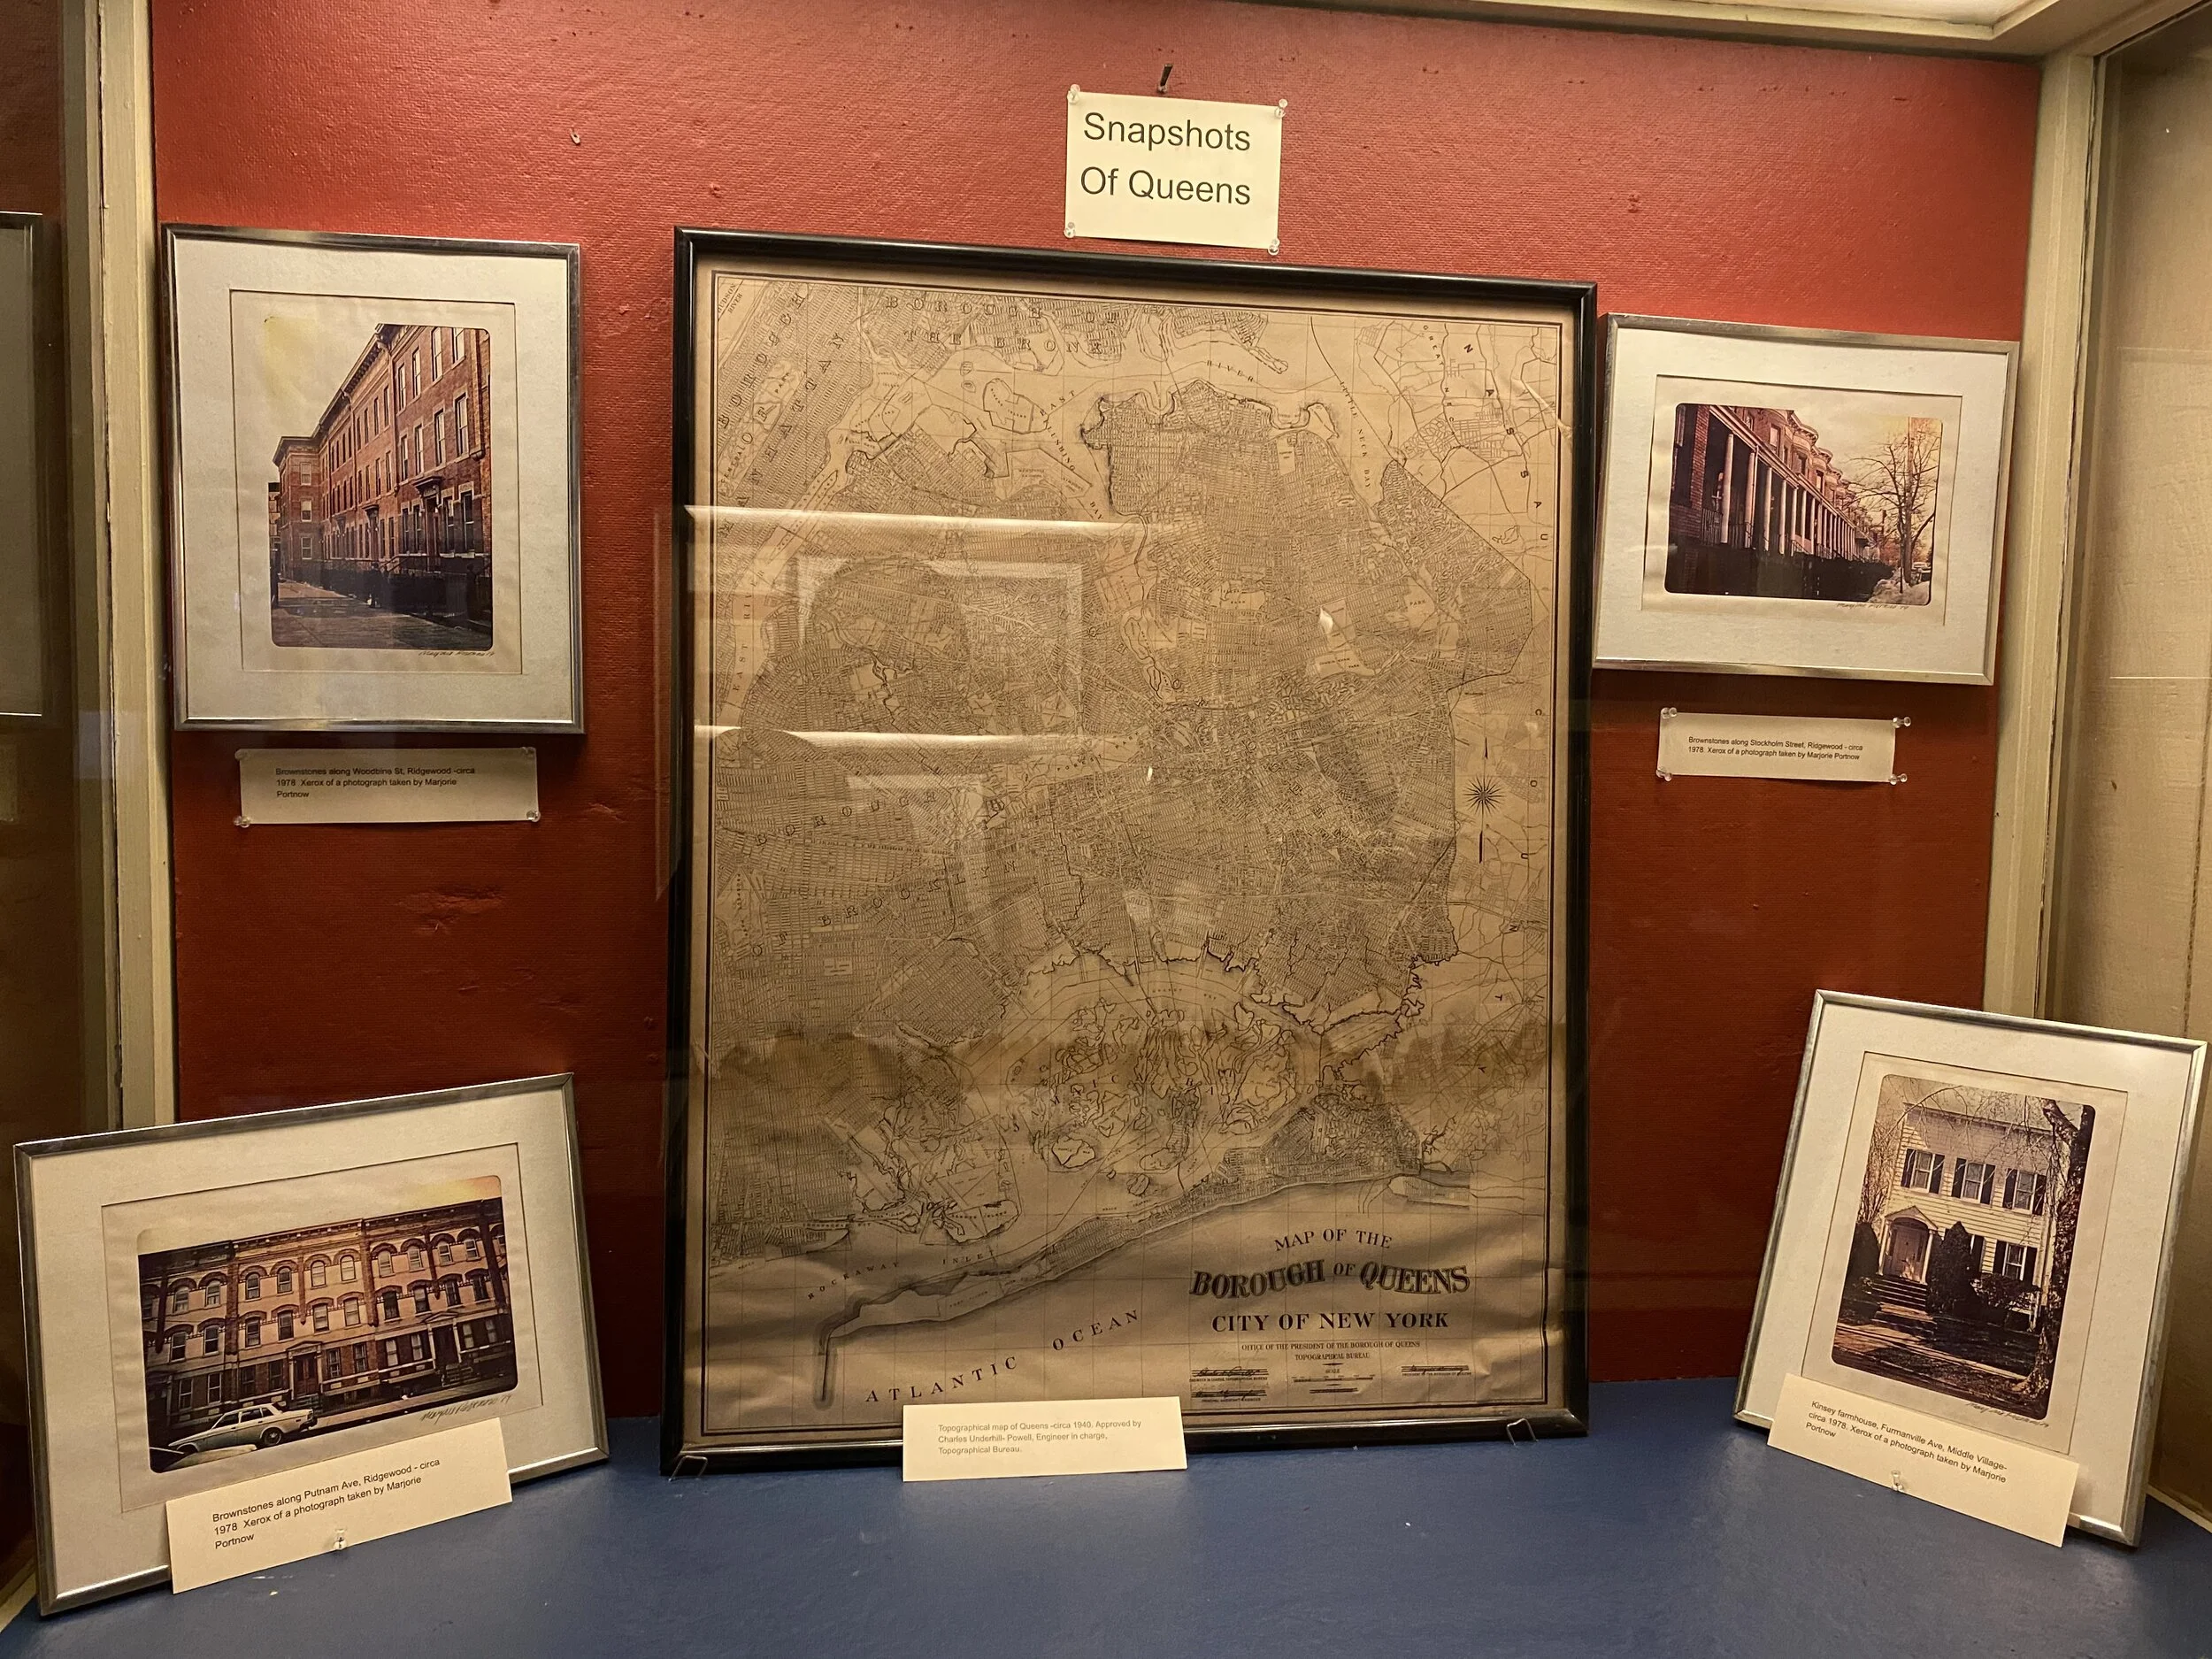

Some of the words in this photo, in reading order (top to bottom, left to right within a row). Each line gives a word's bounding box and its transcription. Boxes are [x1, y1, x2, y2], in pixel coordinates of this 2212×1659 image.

[1084, 112, 1250, 150] Snapshots
[1080, 166, 1118, 196] Of
[1128, 169, 1250, 205] Queens
[1688, 735, 1729, 744] Brownstones
[1731, 738, 1748, 747] along
[1807, 741, 1843, 750] Ridgewood
[1740, 748, 1777, 757] photograph
[1797, 750, 1806, 759] by
[1807, 750, 1832, 759] Marjorie
[275, 766, 327, 775] Brownstones
[328, 767, 350, 776] along
[352, 766, 392, 775] Woodbine
[406, 766, 452, 777] Ridgewood
[342, 778, 388, 787] photograph
[389, 777, 411, 786] taken
[412, 777, 423, 787] by
[424, 776, 457, 787] Marjorie
[276, 789, 310, 798] Portnow
[1273, 1231, 1315, 1251] MAP
[1323, 1228, 1347, 1241] OF
[1356, 1230, 1393, 1249] THE
[1189, 1259, 1326, 1299] BOROUGH
[1333, 1262, 1356, 1276] OF
[1359, 1260, 1471, 1294] QUEENS
[1211, 1315, 1269, 1332] CITY
[1279, 1313, 1310, 1330] OF
[1319, 1312, 1376, 1329] NEW
[1385, 1312, 1449, 1328] YORK
[1290, 1341, 1325, 1350] PRESIDENT
[1395, 1340, 1420, 1348] QUEENS
[865, 1356, 1018, 1403] ATLANTIC
[1052, 1310, 1140, 1352] OCEAN
[938, 1424, 990, 1433] Topographical
[1095, 1419, 1131, 1429] Approved
[1132, 1419, 1141, 1428] by
[1805, 1421, 1837, 1438] Portnow
[1811, 1400, 1837, 1416] Kinsey
[1880, 1423, 1926, 1445] Furmanville
[1947, 1445, 1974, 1460] Middle
[1035, 1432, 1069, 1442] Engineer
[938, 1446, 990, 1455] Topographical
[1809, 1412, 1826, 1423] circa
[1849, 1425, 1872, 1438] Xerox
[1889, 1440, 1934, 1459] photograph
[1936, 1454, 1959, 1467] taken
[1960, 1461, 1971, 1472] by
[1972, 1465, 2006, 1483] Marjorie
[212, 1501, 273, 1522] Brownstones
[276, 1494, 302, 1506] along
[303, 1485, 339, 1499] Putnam
[363, 1464, 411, 1485] Ridgewood
[419, 1459, 440, 1469] circa
[214, 1522, 237, 1535] 1978
[242, 1515, 271, 1528] Xerox
[273, 1509, 283, 1520] of
[293, 1495, 345, 1518] photograph
[347, 1489, 372, 1501] taken
[373, 1486, 384, 1495] by
[386, 1476, 421, 1491] Marjorie
[214, 1533, 254, 1549] Portnow
